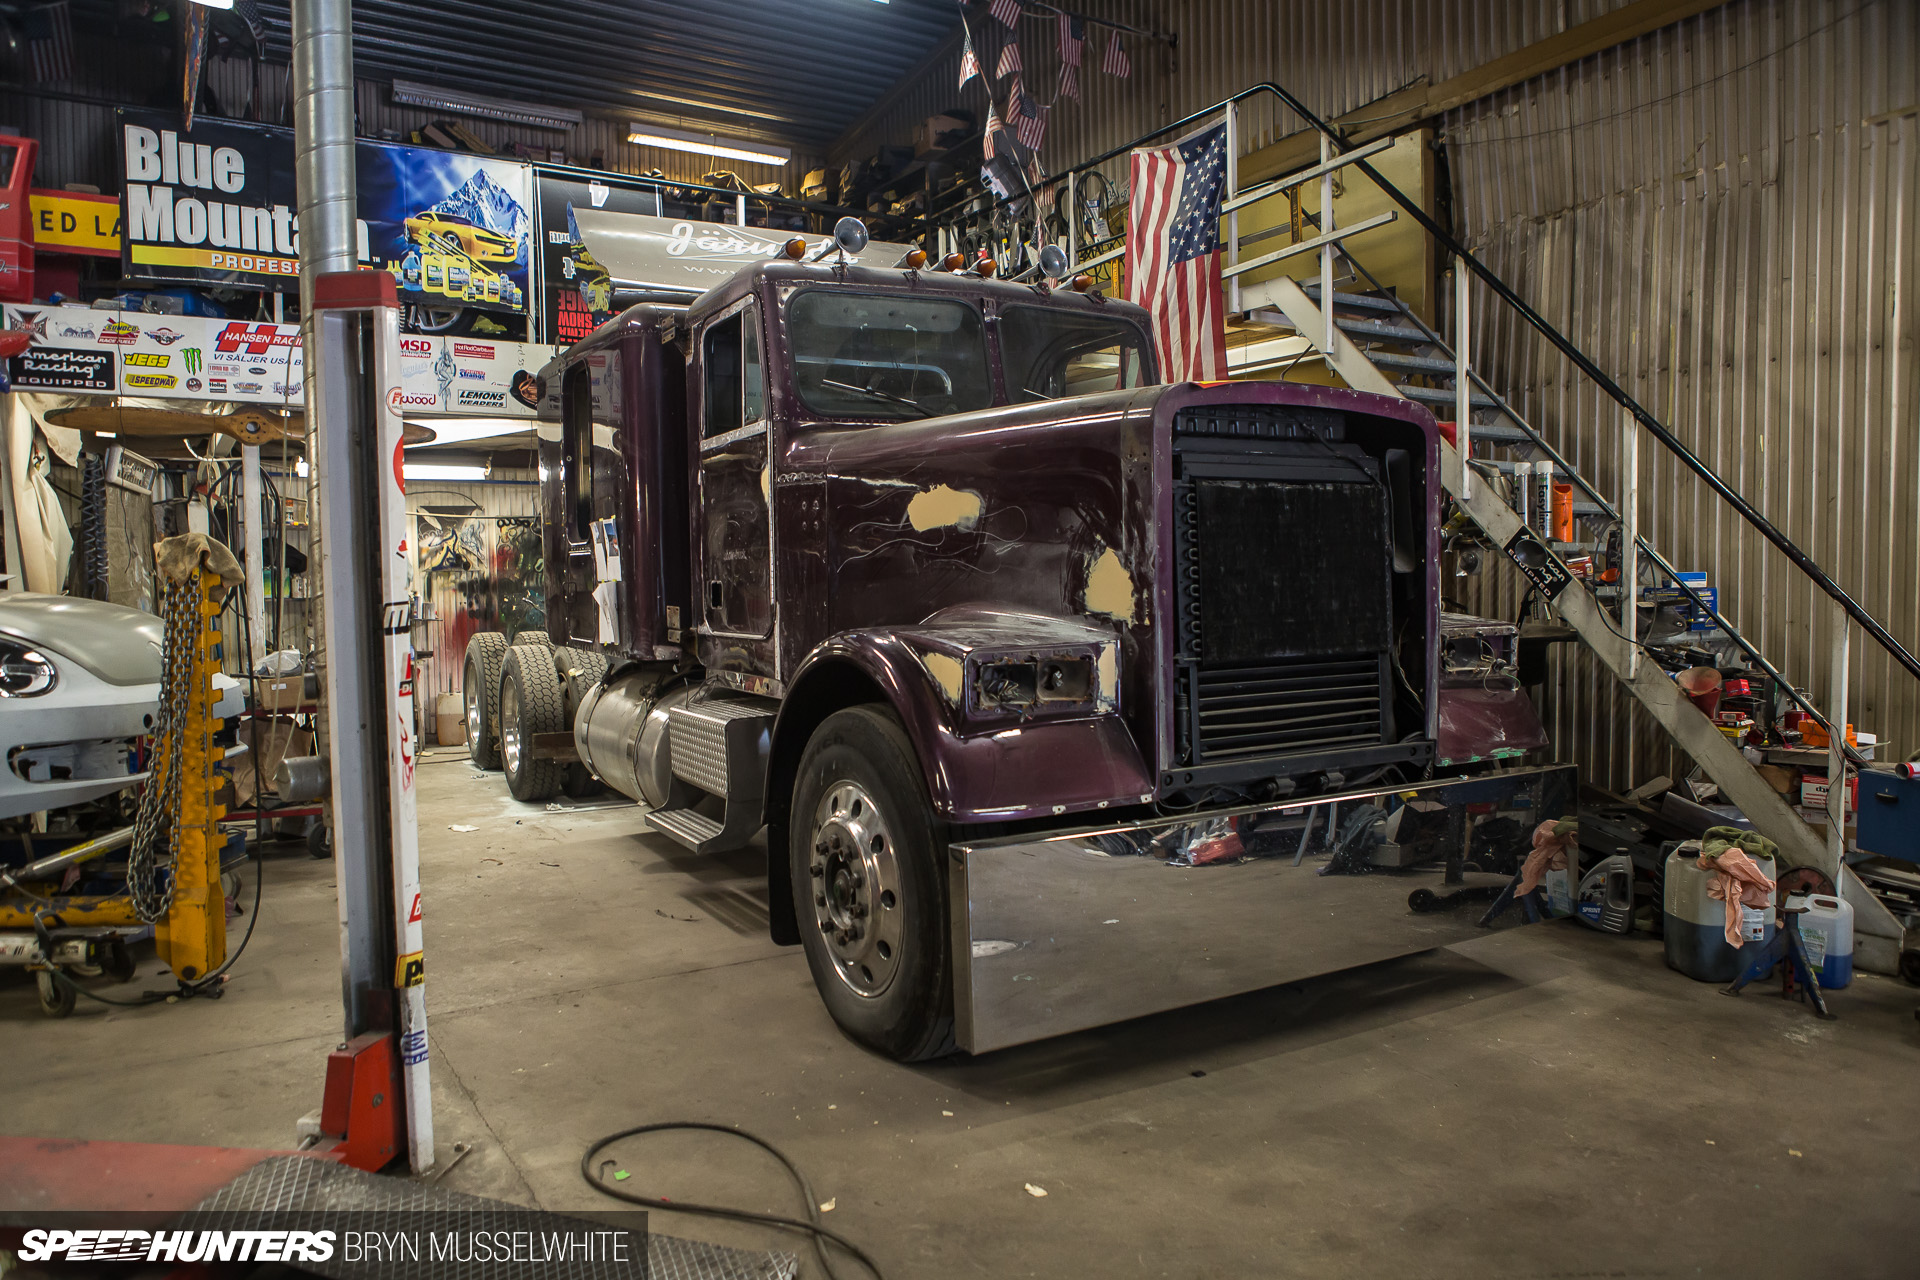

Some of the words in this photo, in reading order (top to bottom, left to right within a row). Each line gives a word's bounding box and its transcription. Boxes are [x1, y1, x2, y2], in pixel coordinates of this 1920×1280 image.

[125, 124, 245, 194] Blue
[557, 311, 593, 328] SHOW
[224, 332, 271, 344] HANSEN
[400, 340, 431, 351] MSD
[18, 350, 107, 364] American
[125, 353, 170, 368] JEGS
[213, 353, 224, 361] VI
[226, 353, 268, 364] SÄLJER
[18, 376, 107, 388] EQUIPPED
[133, 375, 175, 388] SPEEDWAY
[209, 381, 227, 390] Holley
[459, 390, 505, 401] LEMONS
[459, 399, 504, 408] HEADERS
[1537, 484, 1553, 531] Easyline
[1582, 906, 1602, 914] SPRINT
